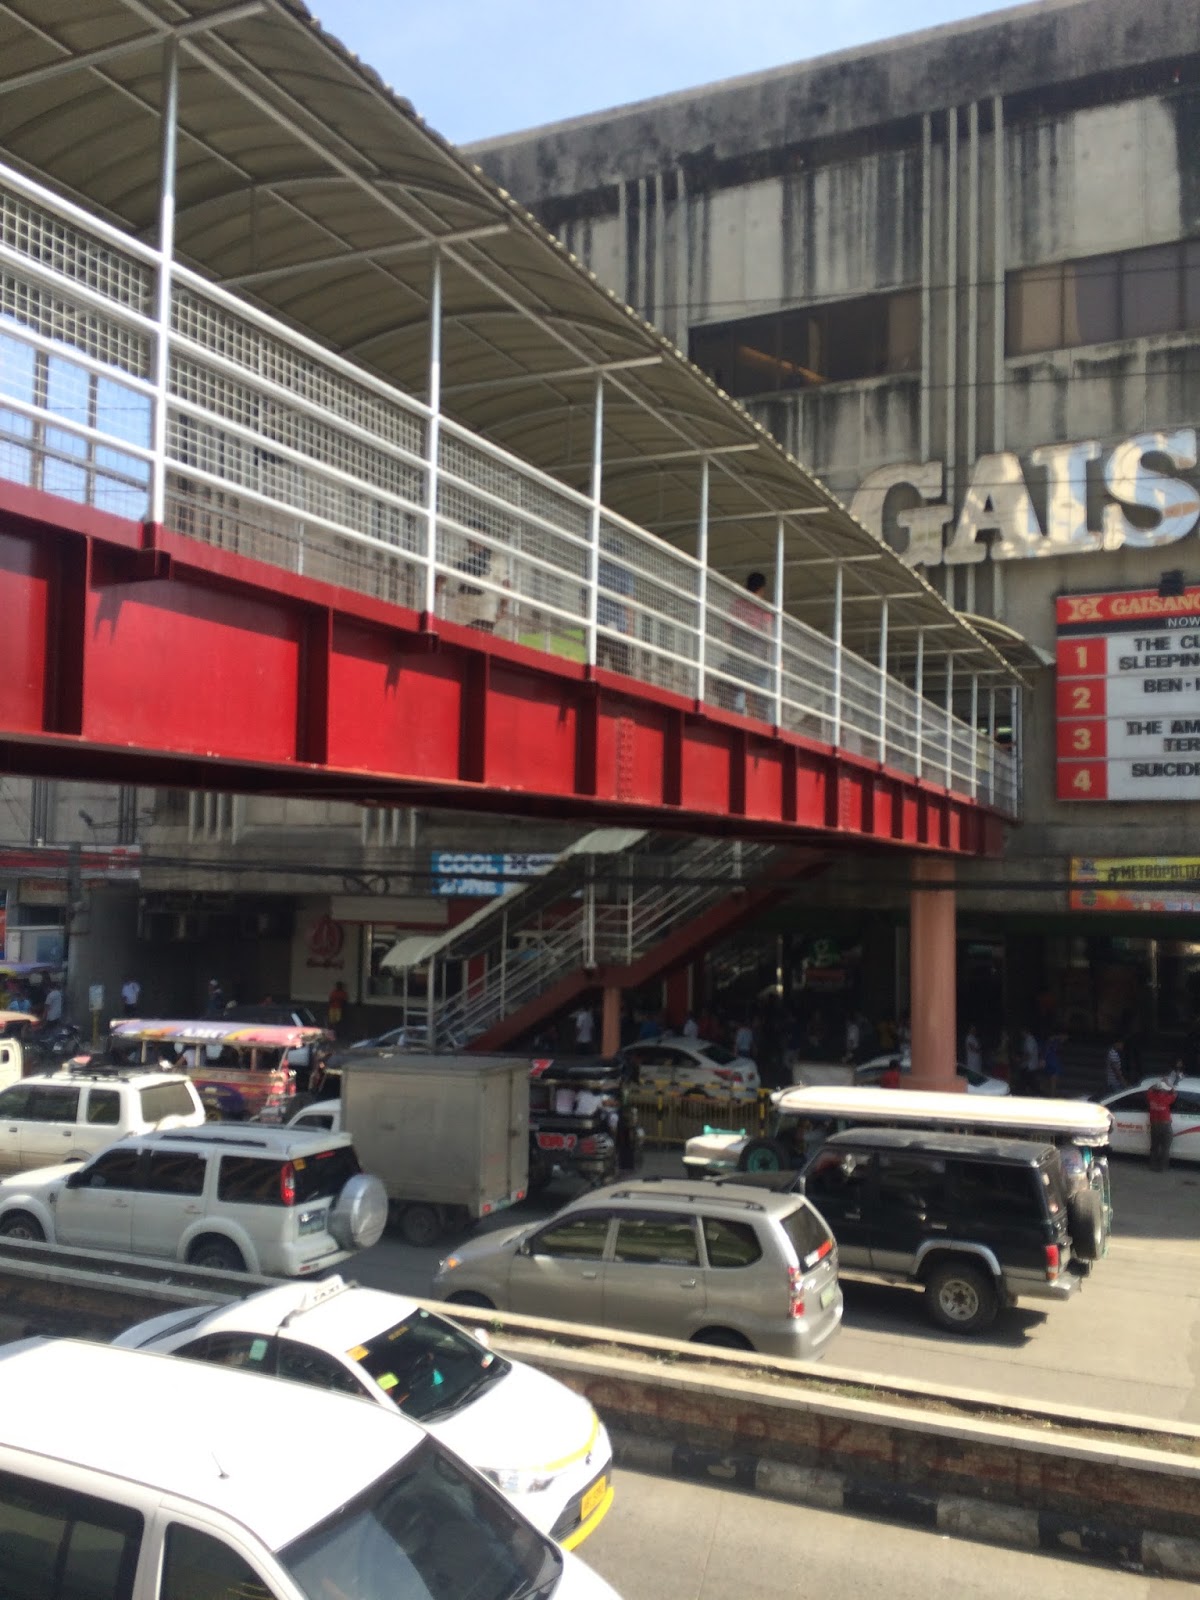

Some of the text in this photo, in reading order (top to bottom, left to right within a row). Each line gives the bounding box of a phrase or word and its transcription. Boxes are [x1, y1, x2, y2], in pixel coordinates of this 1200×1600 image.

[850, 428, 1200, 566] GAIS
[1168, 616, 1200, 628] NOW
[1134, 636, 1170, 651] THE
[1076, 646, 1088, 669] 1
[1119, 653, 1200, 670] SLEEPIN
[1073, 687, 1092, 709] 2
[1126, 720, 1162, 735] THE
[1073, 728, 1092, 750] 3
[1073, 769, 1092, 792] 4
[438, 853, 499, 875] COOL
